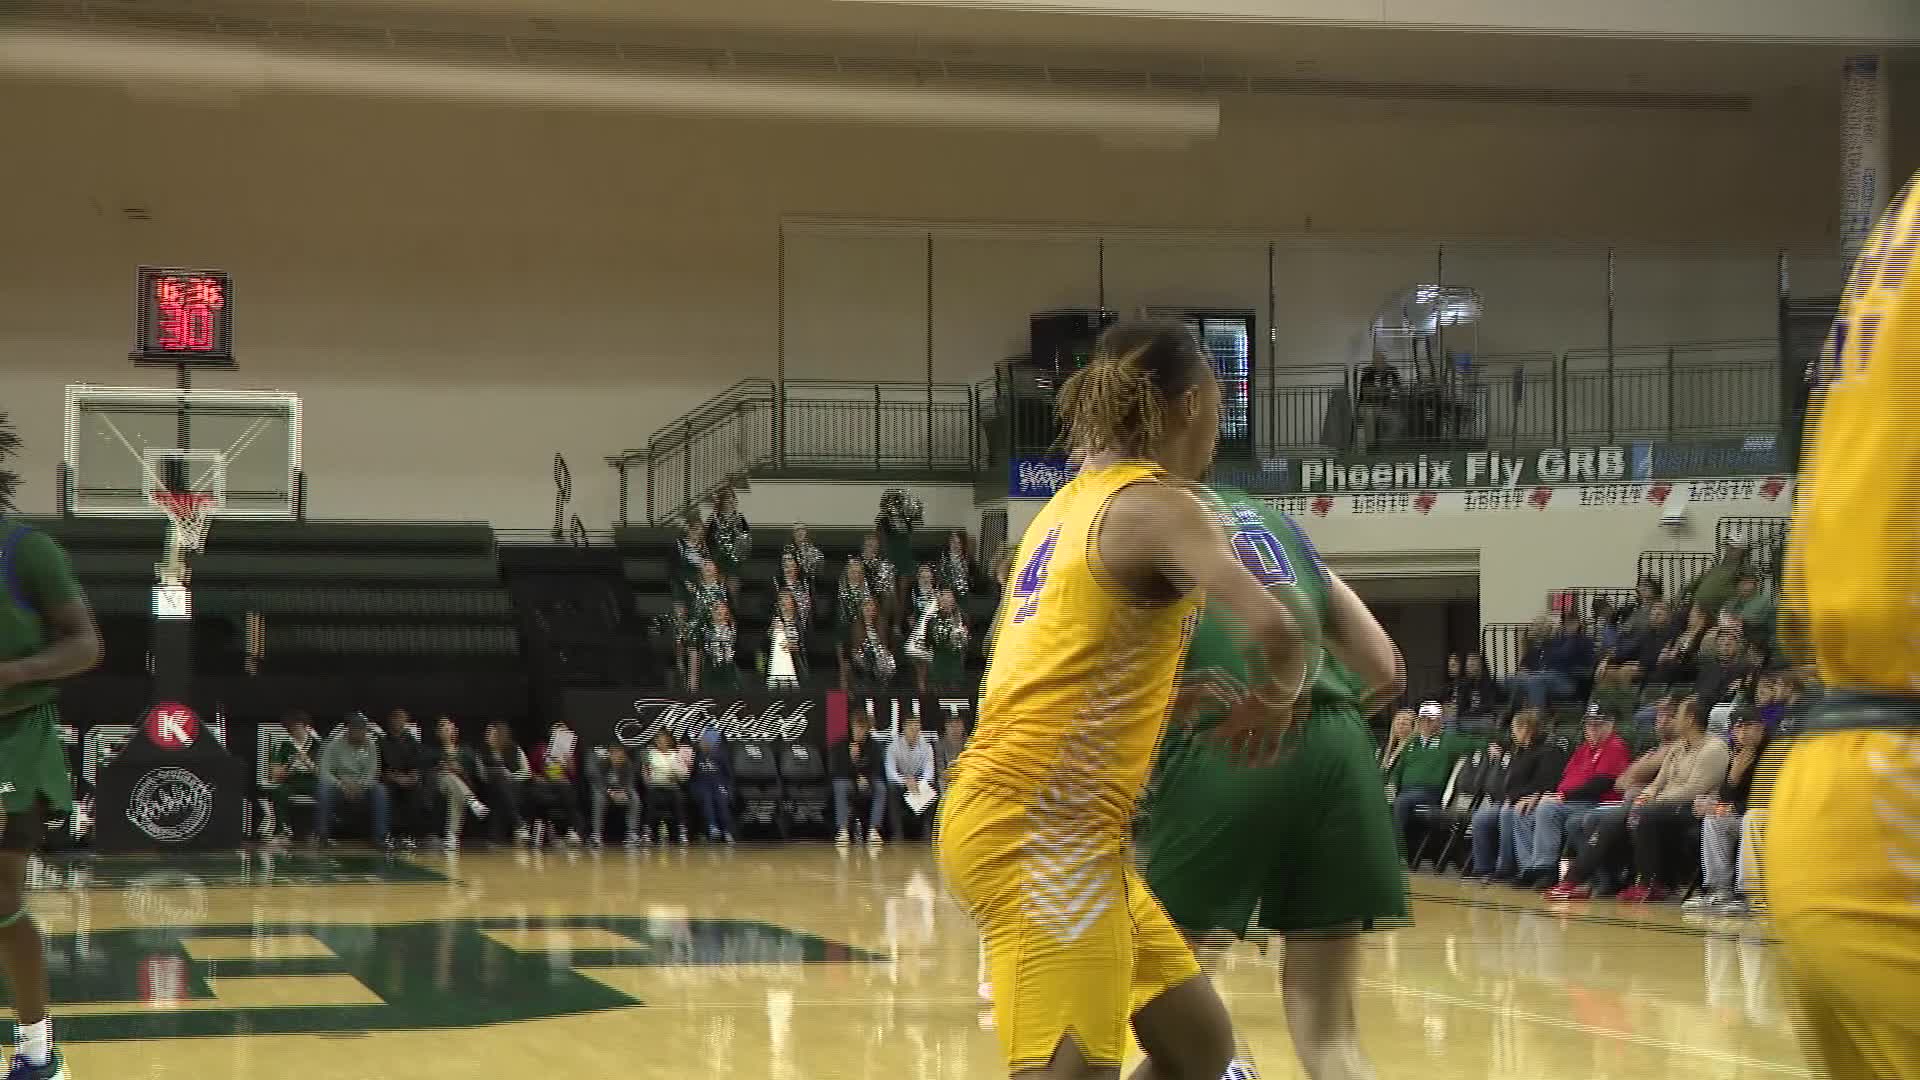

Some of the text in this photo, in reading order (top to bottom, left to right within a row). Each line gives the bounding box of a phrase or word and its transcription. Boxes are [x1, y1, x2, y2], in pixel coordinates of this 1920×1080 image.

[158, 302, 214, 350] 30
[1018, 460, 1076, 494] Hoop
[1301, 453, 1453, 492] Phoenix
[1465, 450, 1524, 491] Fly
[1536, 445, 1625, 483] GRB
[1262, 496, 1307, 516] EGIT
[1351, 492, 1409, 515] LEGIT
[1464, 487, 1524, 511] LEGIT
[1579, 484, 1643, 506] LEGIT
[1688, 479, 1755, 503] LEGIT
[1013, 523, 1063, 623] 4
[158, 709, 194, 748] K
[614, 698, 815, 747] Michelob
[864, 697, 982, 742] ULT
